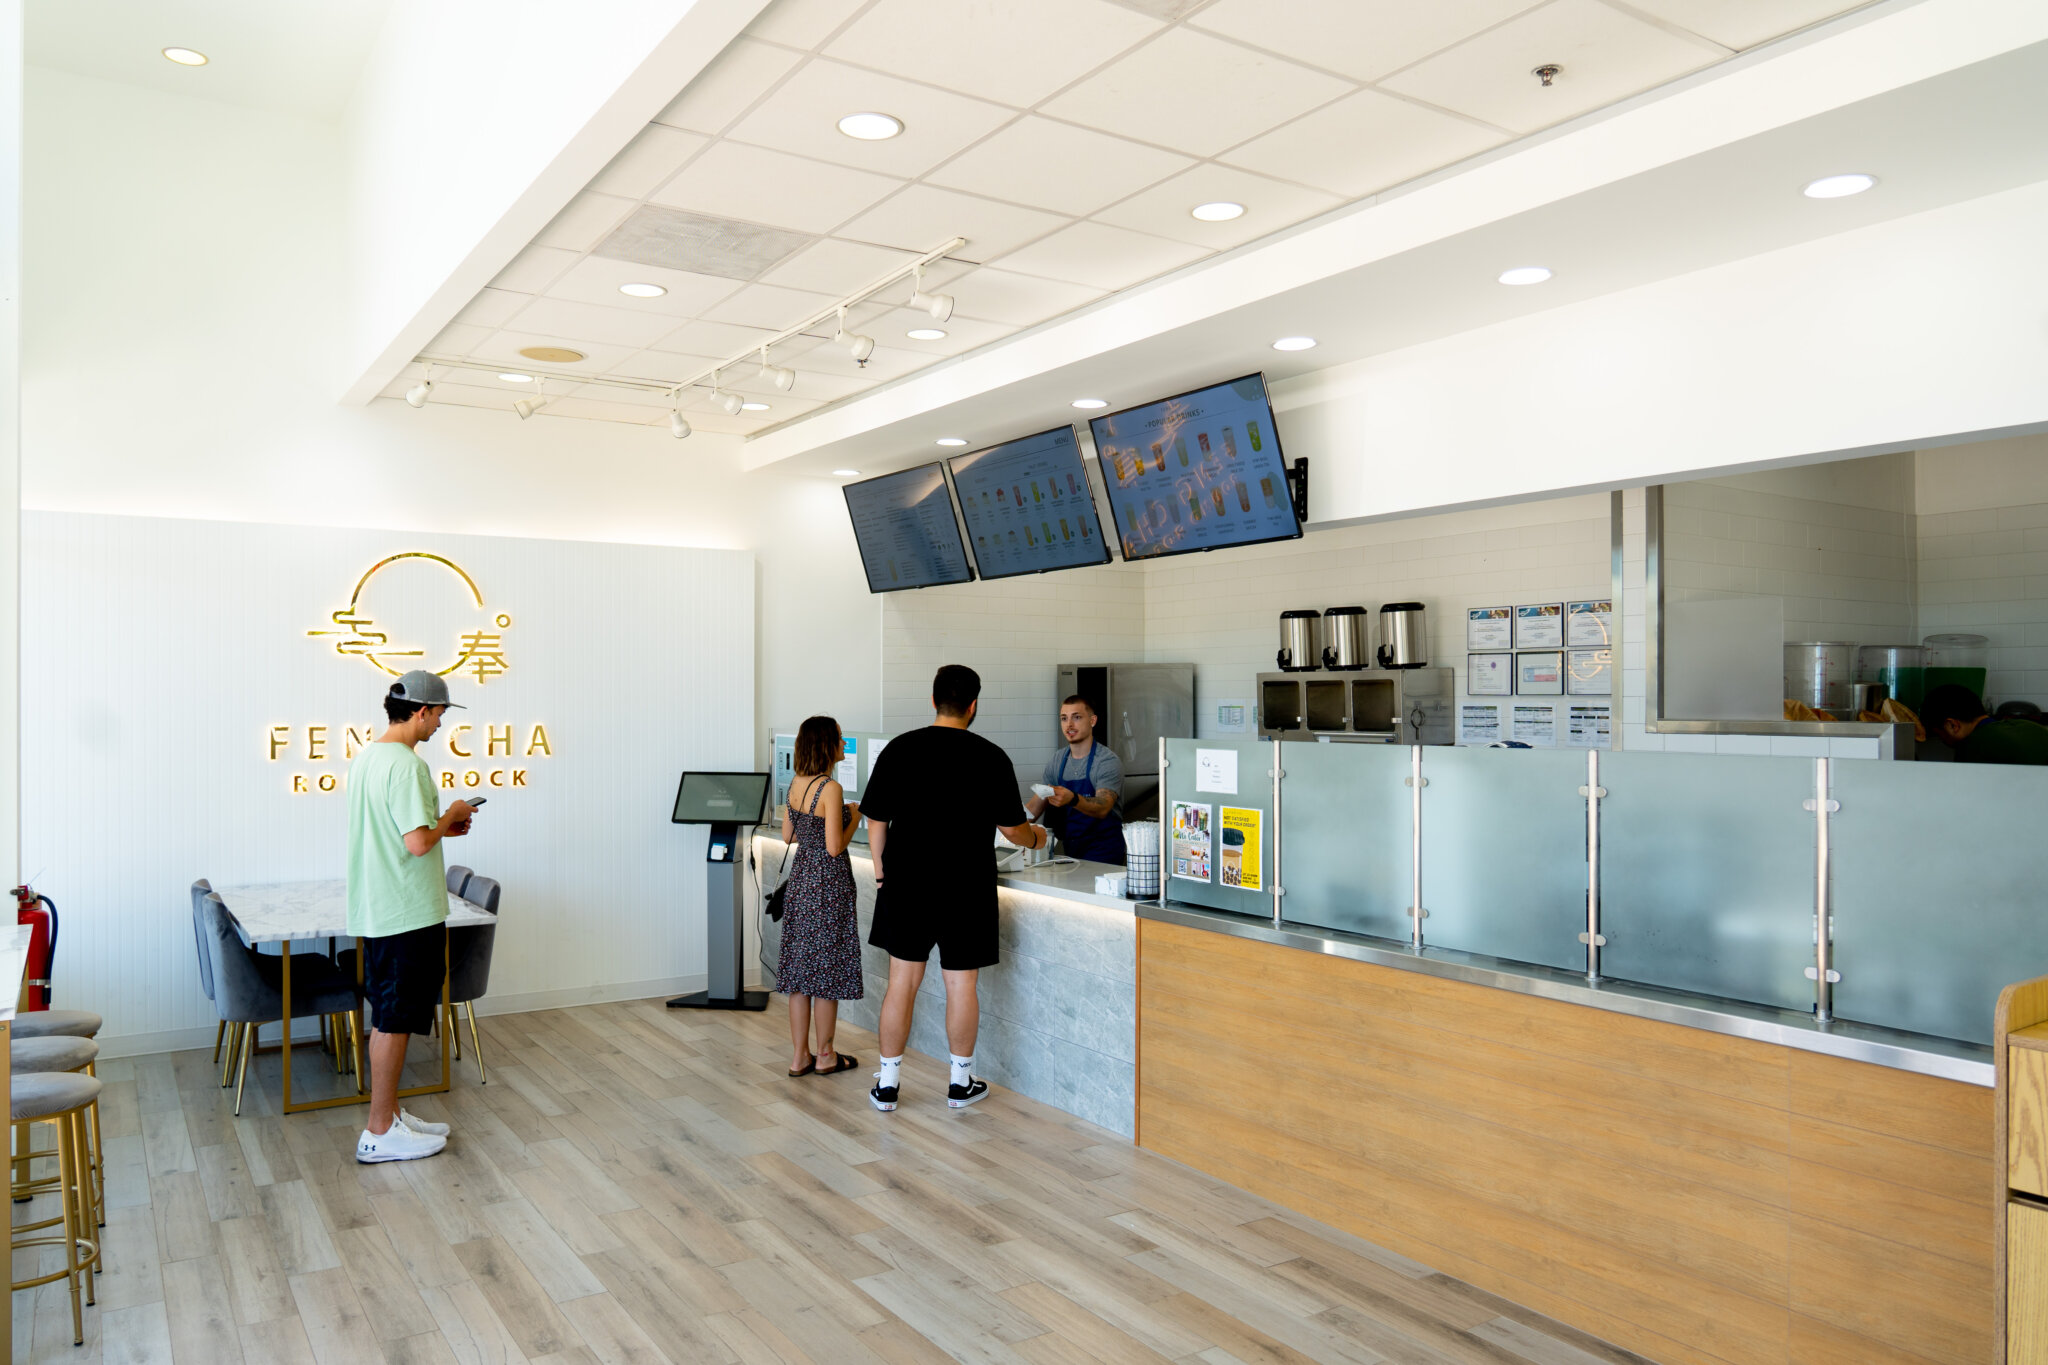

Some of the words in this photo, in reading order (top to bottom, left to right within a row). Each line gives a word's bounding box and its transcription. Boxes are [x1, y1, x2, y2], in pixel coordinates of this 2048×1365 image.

[1054, 436, 1069, 445] MENU
[269, 726, 373, 761] FEN
[449, 724, 552, 758] CHA
[441, 769, 527, 788] ROCK
